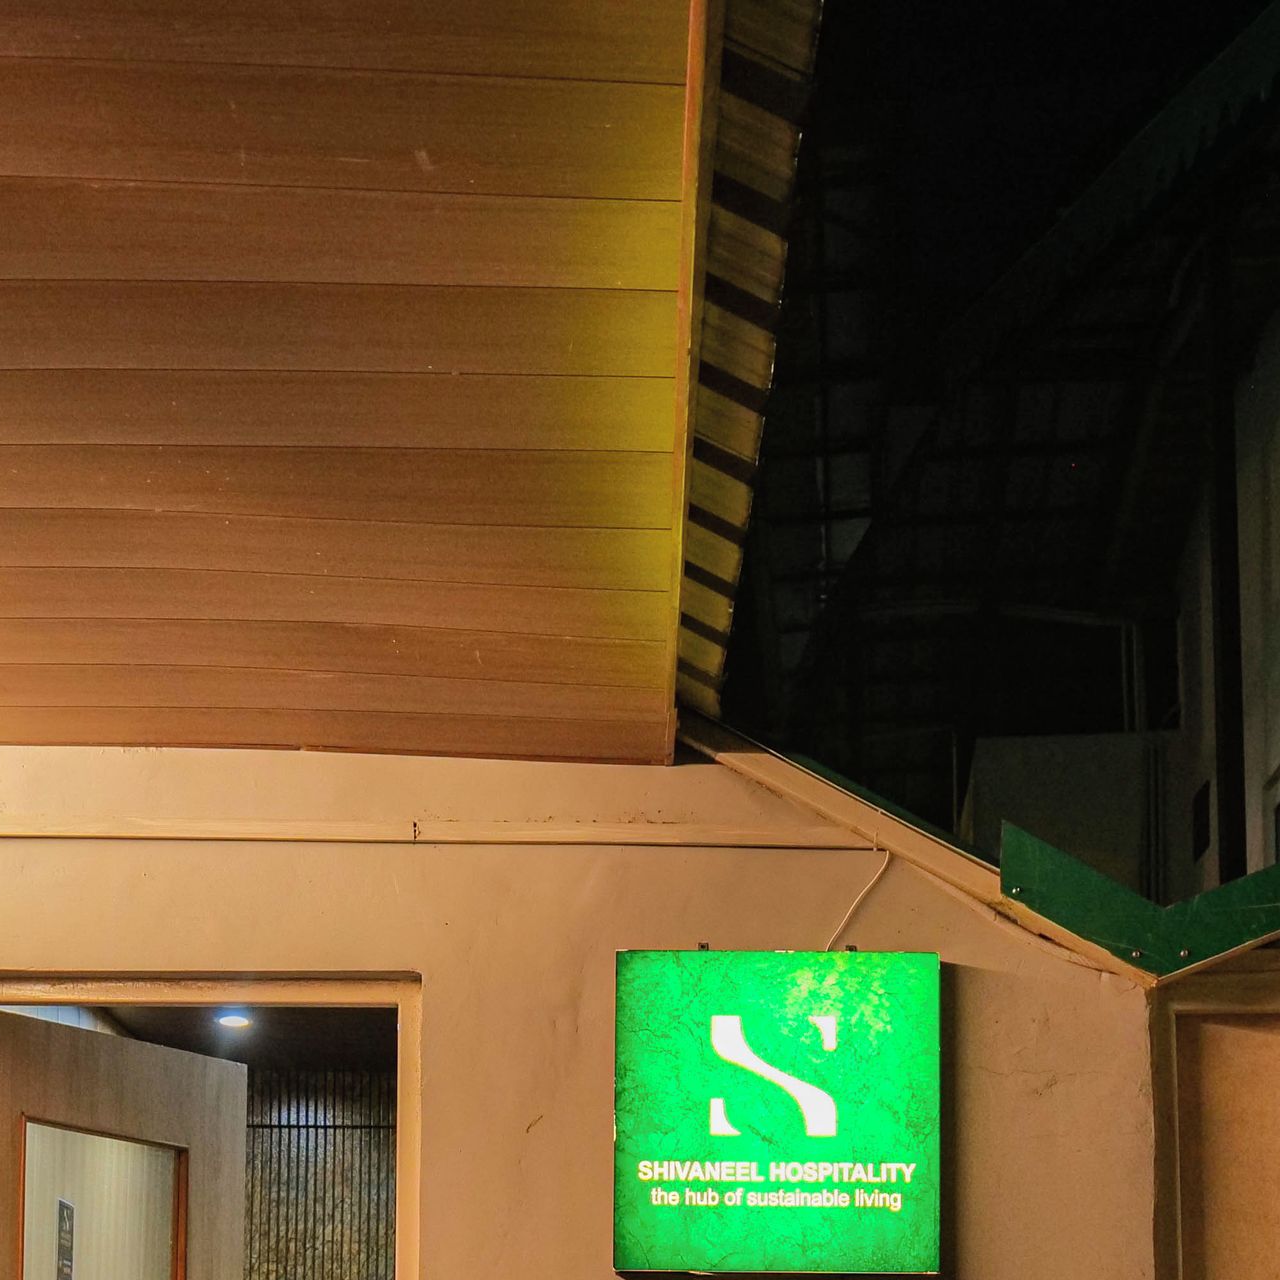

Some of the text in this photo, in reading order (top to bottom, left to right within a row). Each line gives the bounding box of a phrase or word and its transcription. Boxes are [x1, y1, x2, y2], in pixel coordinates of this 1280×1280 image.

[637, 1161, 916, 1183] SHIVANEEL HOSPITALITY
[651, 1187, 902, 1212] the hub of sustainable living
